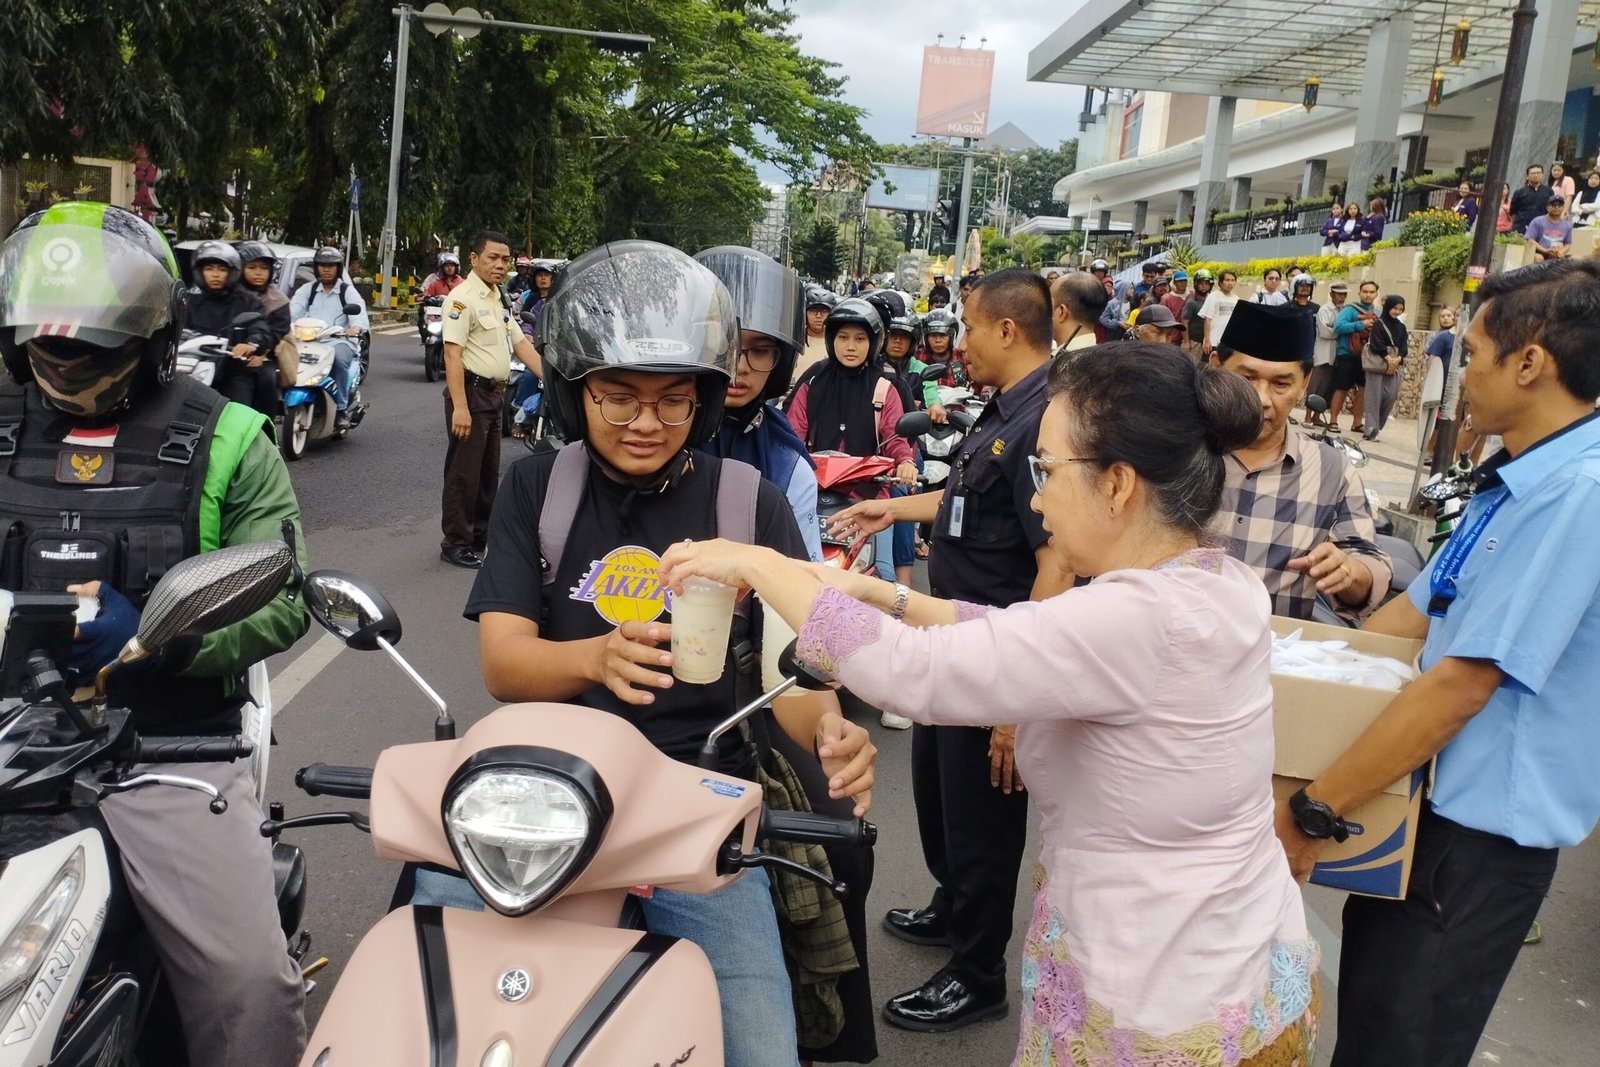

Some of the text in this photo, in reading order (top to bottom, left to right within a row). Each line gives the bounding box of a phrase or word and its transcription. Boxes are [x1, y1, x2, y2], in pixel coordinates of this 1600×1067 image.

[947, 123, 984, 135] MASUK
[614, 564, 637, 573] LOS
[3, 918, 88, 1046] VARIO
